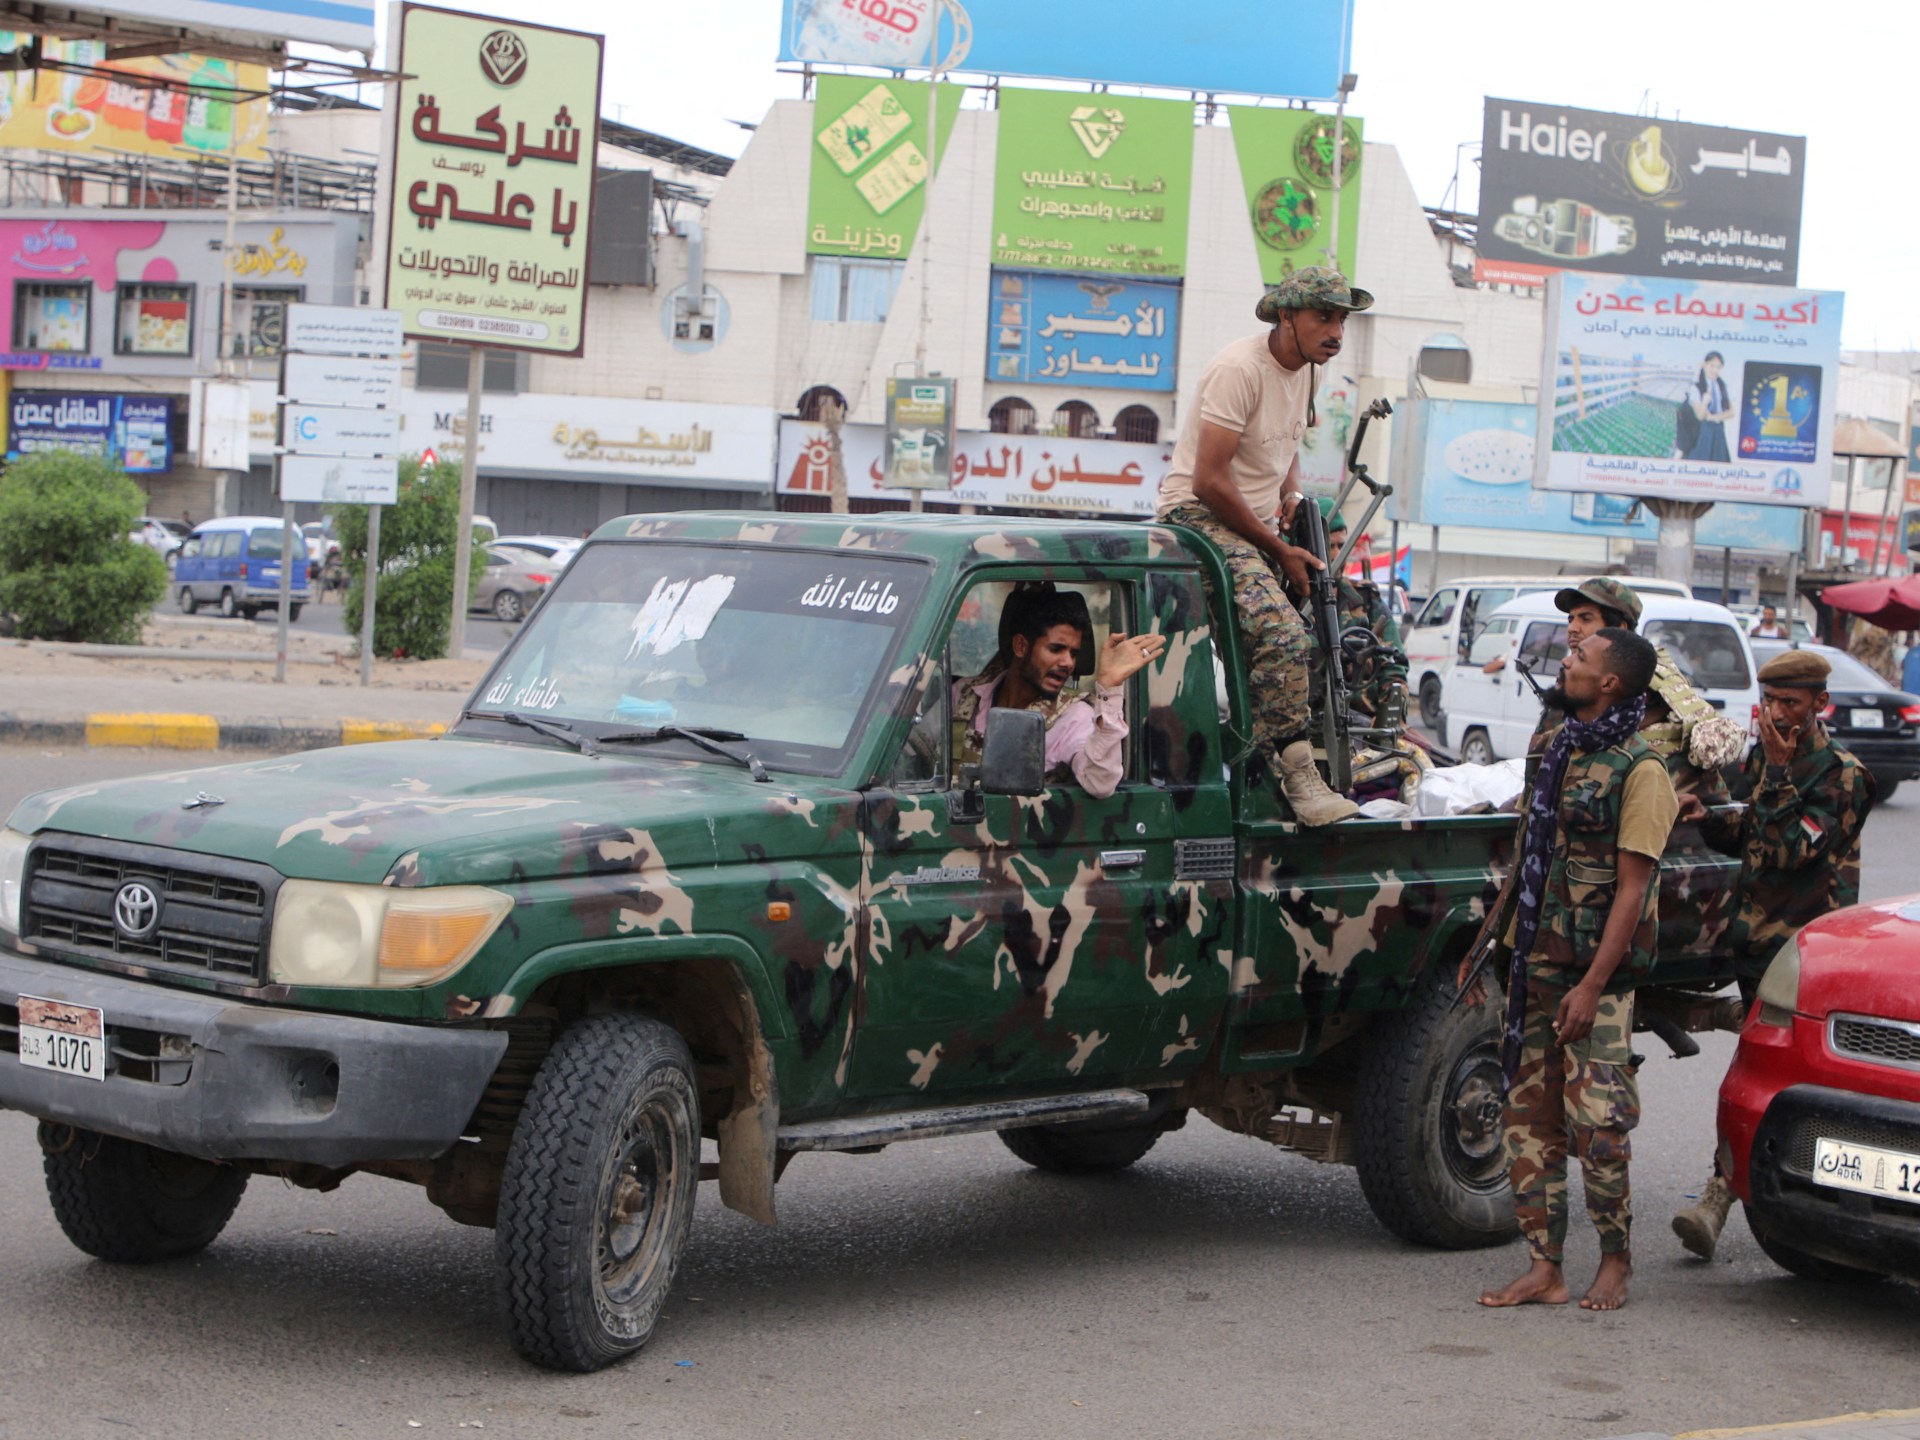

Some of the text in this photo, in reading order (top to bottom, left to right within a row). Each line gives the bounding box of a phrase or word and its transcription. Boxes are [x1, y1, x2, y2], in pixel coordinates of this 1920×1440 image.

[411, 93, 580, 168] شركة
[1501, 109, 1607, 163] Haier
[433, 154, 486, 178] يوسف
[1690, 138, 1792, 178] هاير
[408, 178, 578, 248] با علي
[399, 246, 580, 290] للصرافة والتحويلات
[1038, 299, 1165, 338] الأمير
[1576, 291, 1818, 329] أكيد سماء عدن
[1701, 328, 1770, 344] مستقبل
[1773, 334, 1808, 347] حيث
[1038, 345, 1161, 378] للمعاوز
[14, 397, 53, 427] عدن
[1030, 452, 1144, 492] عدن
[950, 489, 1155, 512] ADEN INTERNATIONAL MA
[801, 573, 899, 616] ماشاء الله
[513, 676, 560, 711] ماشاء
[47, 1034, 91, 1073] 1070
[1821, 1152, 1861, 1173] عدن
[1837, 1168, 1863, 1182] ADEN
